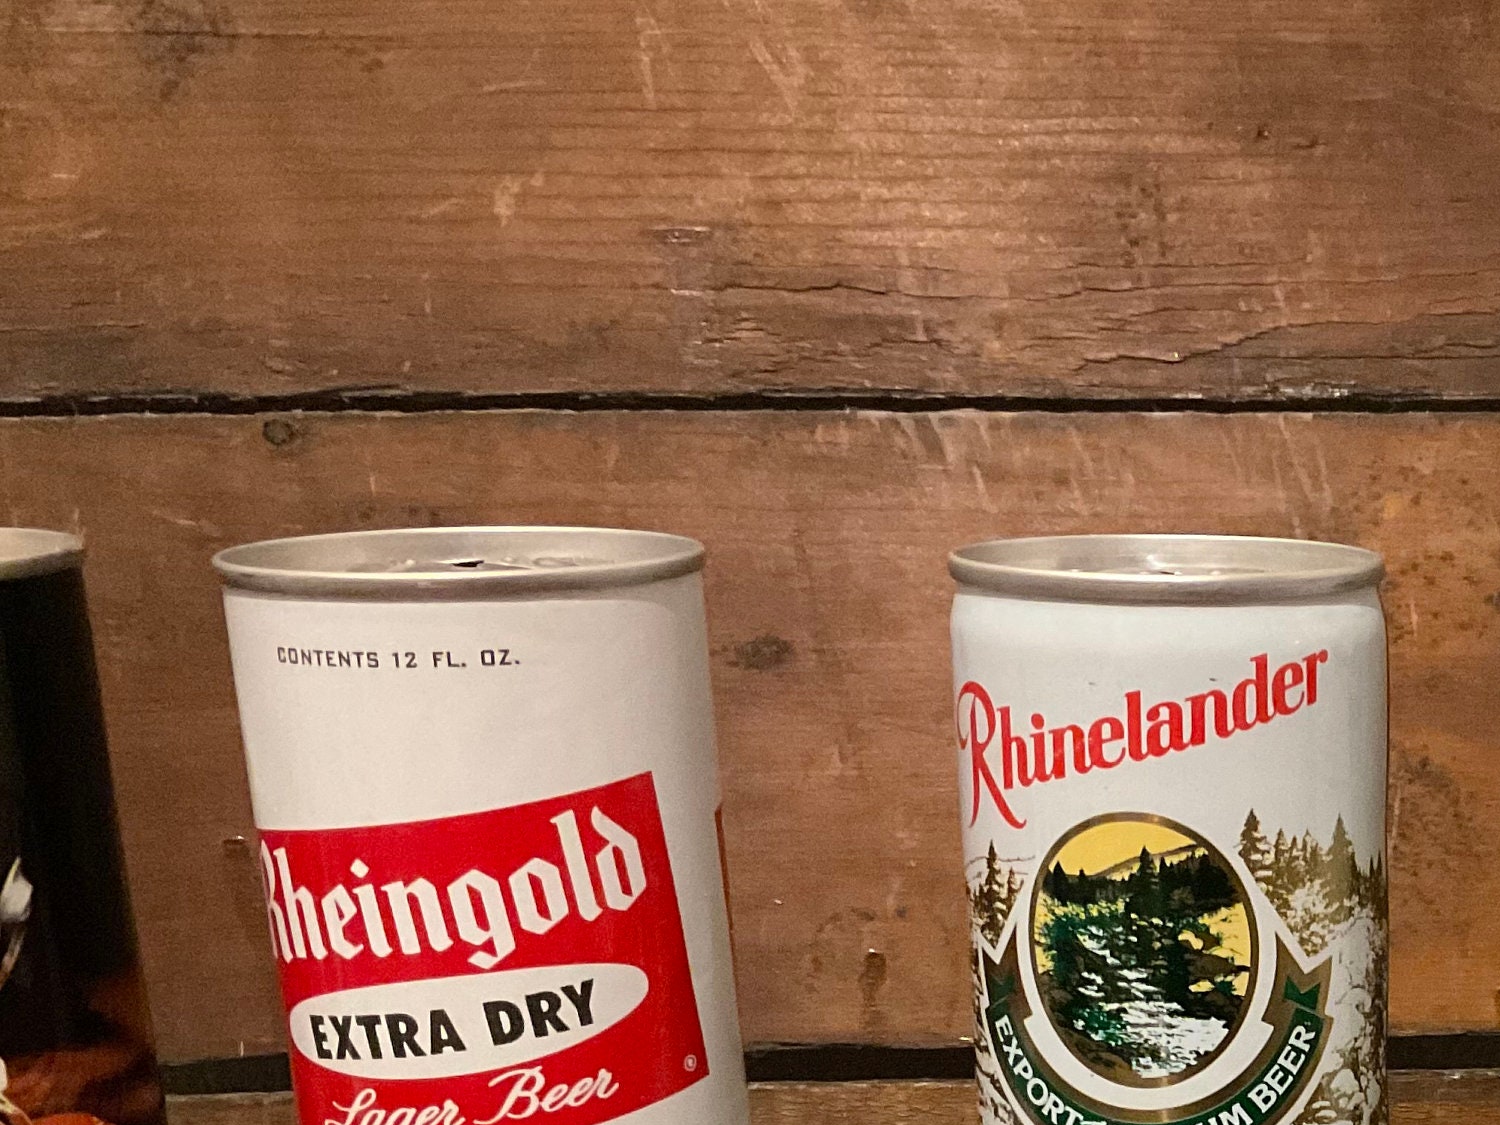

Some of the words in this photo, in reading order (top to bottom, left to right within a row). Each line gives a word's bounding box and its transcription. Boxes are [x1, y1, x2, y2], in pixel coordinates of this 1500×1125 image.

[277, 647, 380, 668] CONTENTS
[392, 651, 418, 669] 12
[432, 651, 467, 668] FL.
[480, 649, 521, 667] OZ.
[957, 648, 1329, 829] Rhinelander
[309, 1009, 467, 1062] EXTRA
[482, 978, 595, 1047] DRY
[473, 1066, 619, 1125] Beer
[1248, 1023, 1316, 1114] BEER
